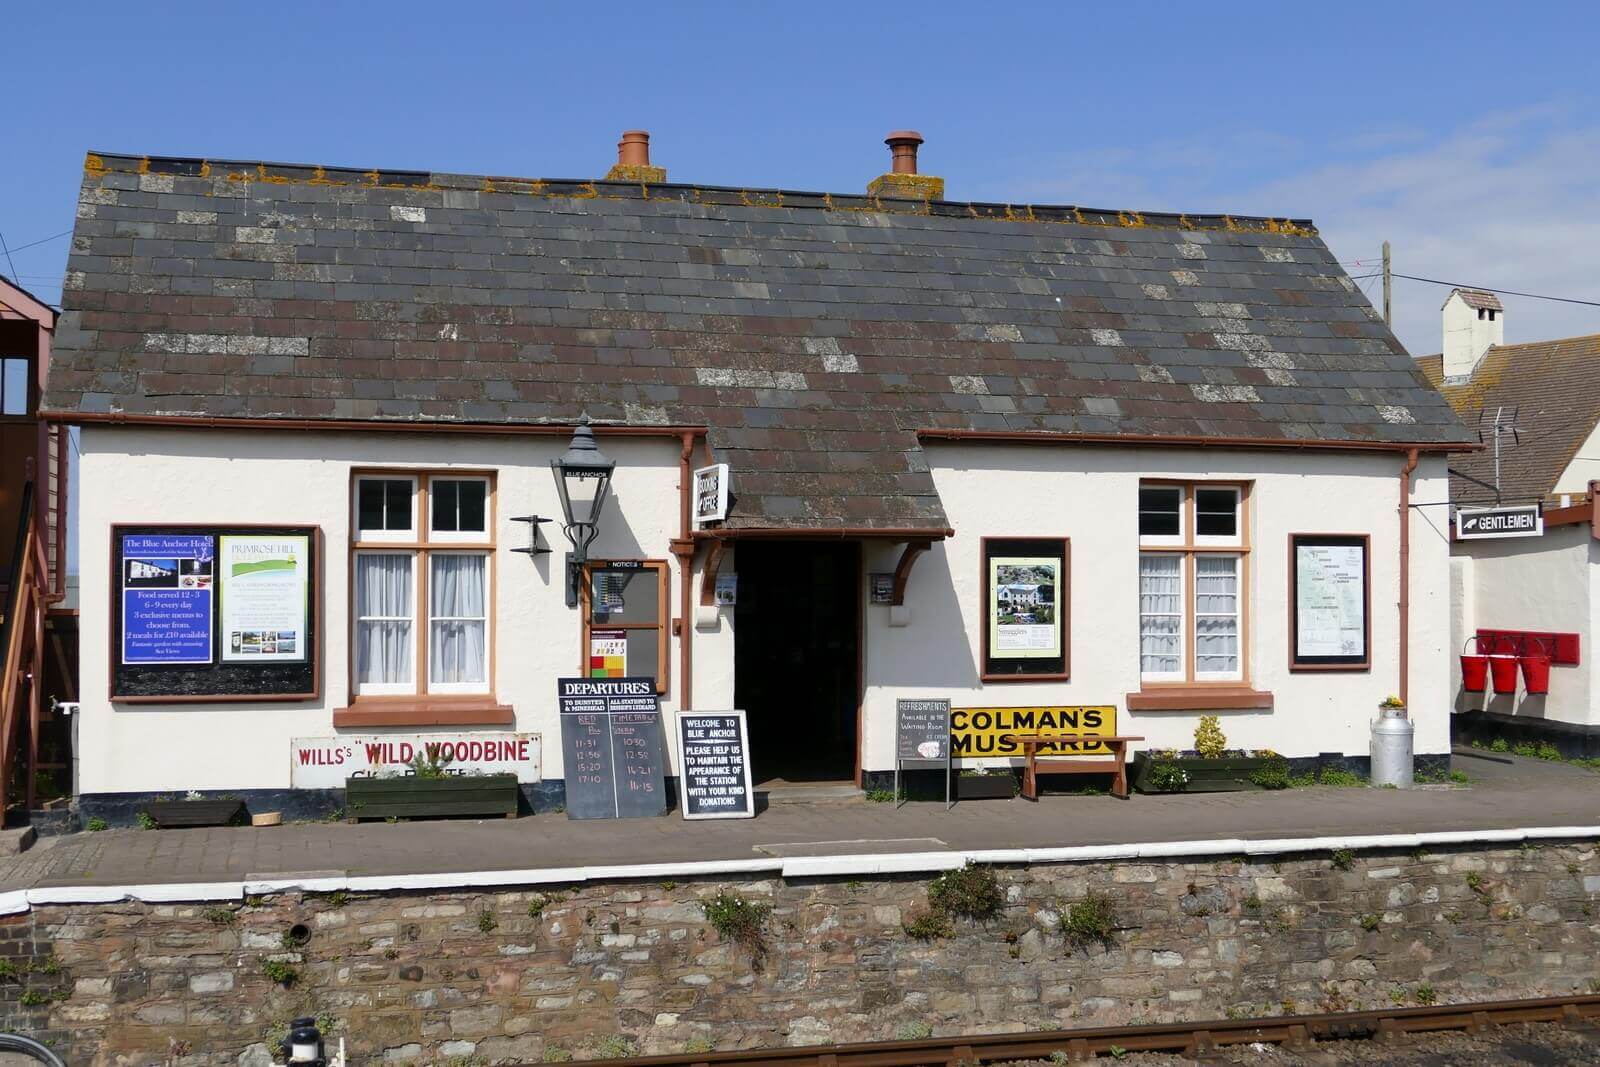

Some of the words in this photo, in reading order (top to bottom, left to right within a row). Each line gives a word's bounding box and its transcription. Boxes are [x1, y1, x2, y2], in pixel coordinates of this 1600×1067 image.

[702, 495, 718, 511] OFFICE
[1479, 514, 1533, 529] GENTLEMEN
[137, 591, 157, 599] Food
[157, 591, 180, 599] served
[161, 602, 179, 610] every
[181, 601, 192, 610] day
[140, 611, 171, 619] exclusive
[146, 621, 170, 629] choose
[180, 631, 209, 639] available
[565, 682, 650, 695] DEPARTURES
[900, 702, 947, 711] REFRESHMENTS
[578, 715, 596, 724] RED
[686, 719, 720, 728] WELCOME
[726, 719, 735, 727] TO
[951, 709, 1103, 730] COLMAN'S
[687, 730, 704, 738] BLUE
[709, 729, 736, 737] ANCHOR
[951, 733, 1102, 753] MUSARD
[686, 747, 711, 755] PLEASE
[713, 746, 729, 754] HELP
[731, 746, 740, 754] US
[686, 757, 695, 765] TO
[697, 757, 728, 765] MAINTAIN
[729, 756, 743, 764] THE
[688, 767, 730, 776] APPEARANCE
[732, 766, 742, 774] OF
[695, 777, 708, 785] THE
[710, 776, 737, 785] STATION
[688, 788, 706, 796] WITH
[708, 787, 726, 795] YOUR
[729, 786, 744, 794] KIND
[699, 797, 736, 806] DONATIONS
